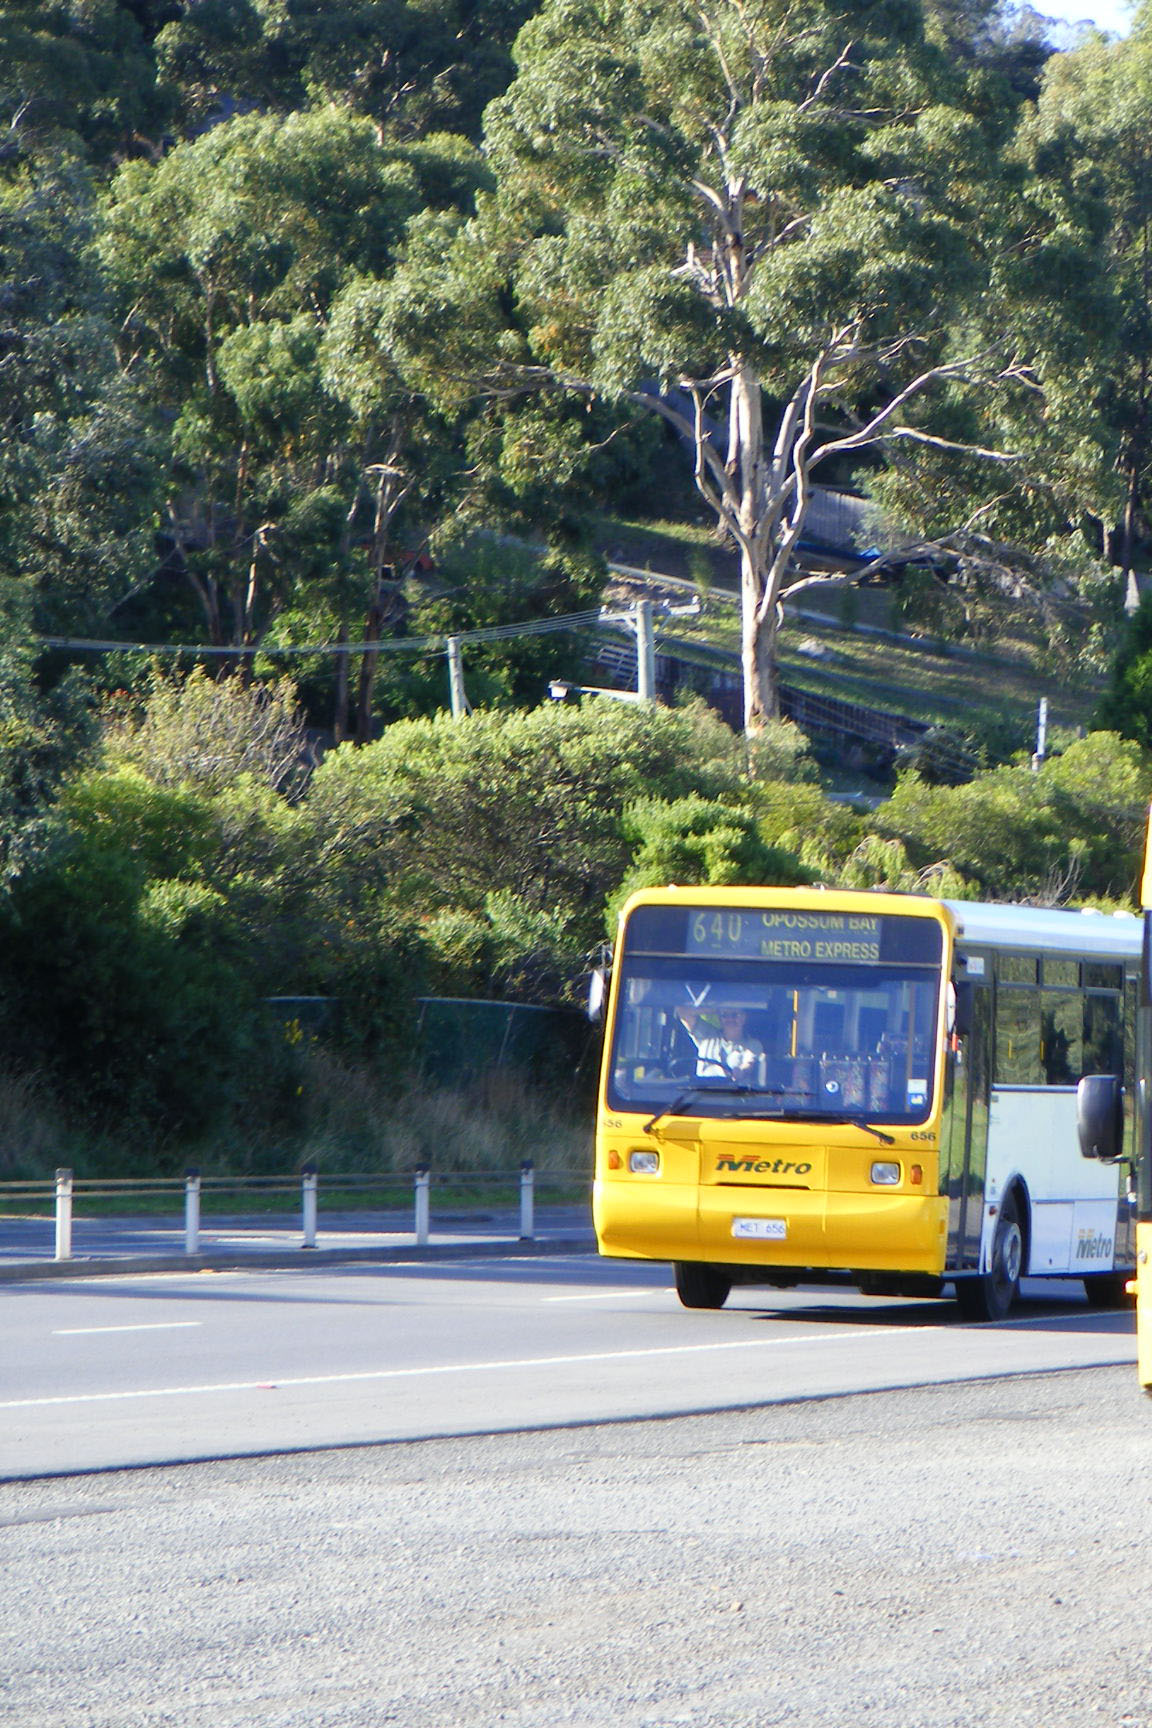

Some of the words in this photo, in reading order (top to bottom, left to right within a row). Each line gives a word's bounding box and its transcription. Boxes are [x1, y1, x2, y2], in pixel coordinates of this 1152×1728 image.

[693, 912, 743, 943] 640
[849, 917, 879, 932] BAY
[761, 940, 812, 958] METRO
[816, 942, 880, 961] EXPRESS
[911, 1131, 937, 1142] 656
[715, 1153, 813, 1175] Metro
[766, 1224, 786, 1236] 656
[1076, 1229, 1112, 1260] Metro
